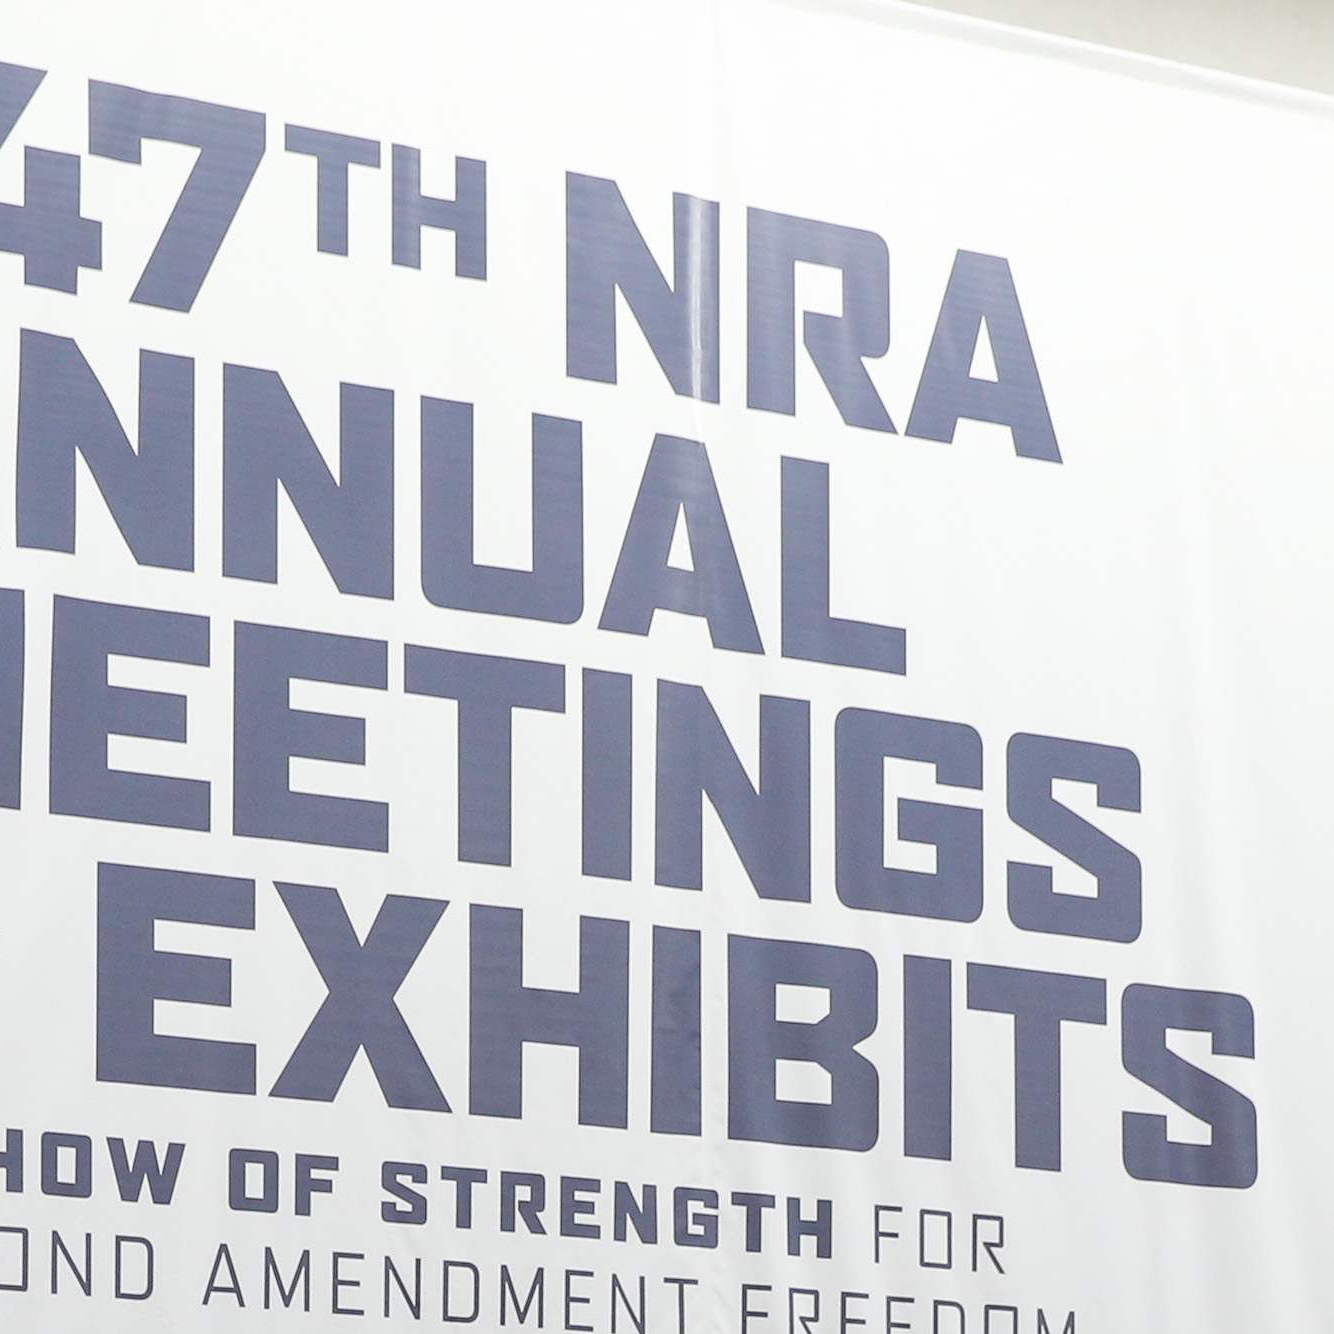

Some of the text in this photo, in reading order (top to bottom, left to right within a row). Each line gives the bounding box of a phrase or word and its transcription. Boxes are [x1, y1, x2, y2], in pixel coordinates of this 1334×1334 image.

[565, 169, 1064, 465] NRA
[95, 860, 1259, 1190] EXHIBITS
[227, 1148, 340, 1218] OF
[379, 1160, 834, 1262] STRENGTH
[872, 1205, 1008, 1275] FOR
